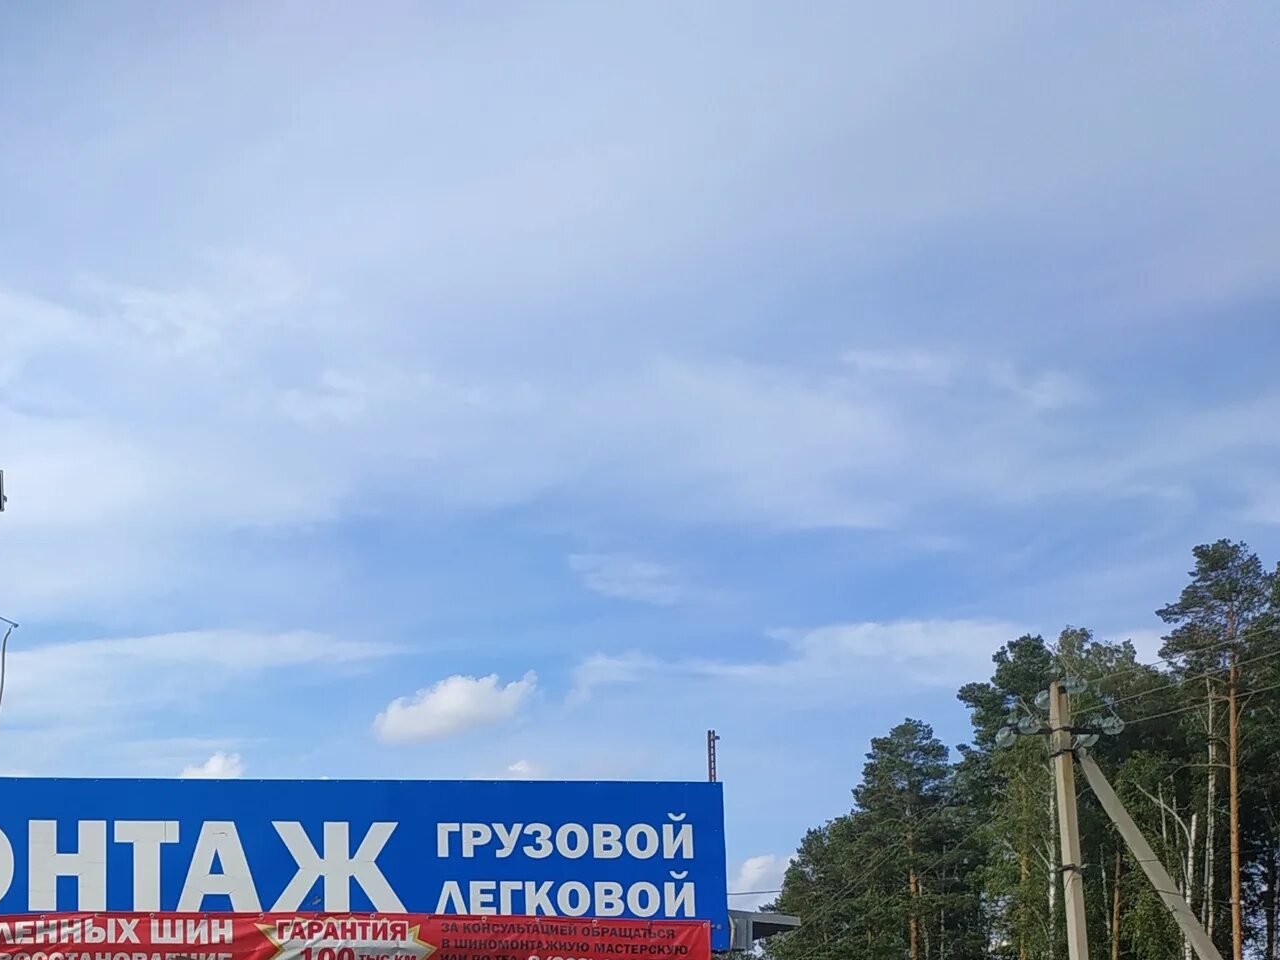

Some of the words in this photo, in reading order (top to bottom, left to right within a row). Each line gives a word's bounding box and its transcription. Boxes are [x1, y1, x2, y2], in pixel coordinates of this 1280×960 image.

[437, 813, 695, 859] ГРУЗОВОЙ
[435, 871, 696, 918] ЛЕГКОВОЙ
[151, 919, 233, 945] ШИН
[276, 920, 409, 942] ГАРАНТИЯ
[441, 922, 458, 933] ЗА
[463, 922, 577, 936] КОНСУЛЬТАЦИЕЙ
[582, 926, 675, 939] ОБРАЩАТЬСЯ
[442, 938, 450, 948] В
[455, 938, 589, 952] ШИНОМОНТАЖНУЮ
[594, 943, 688, 955] МАСТЕРСКУЮ
